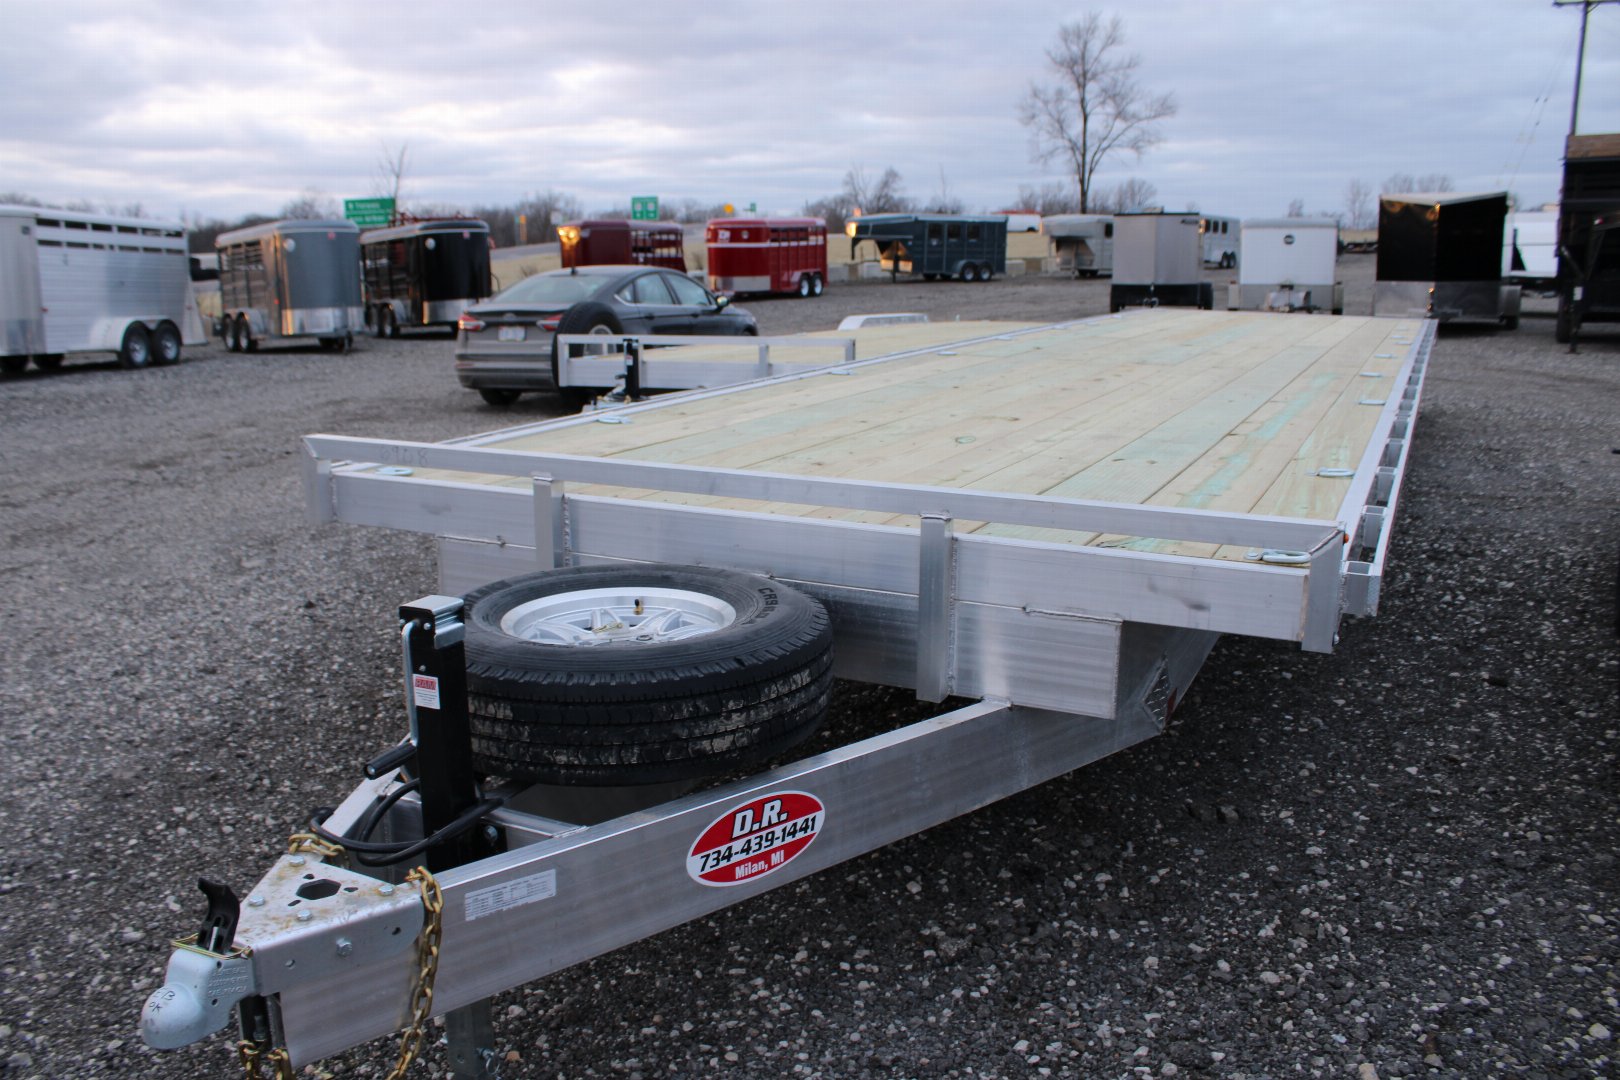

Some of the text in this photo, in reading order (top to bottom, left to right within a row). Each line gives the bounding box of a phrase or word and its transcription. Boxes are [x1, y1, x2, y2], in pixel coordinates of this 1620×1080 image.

[731, 799, 788, 839] D.R.
[700, 815, 817, 872] 734-439-1441
[735, 850, 784, 880] Milan, MI
